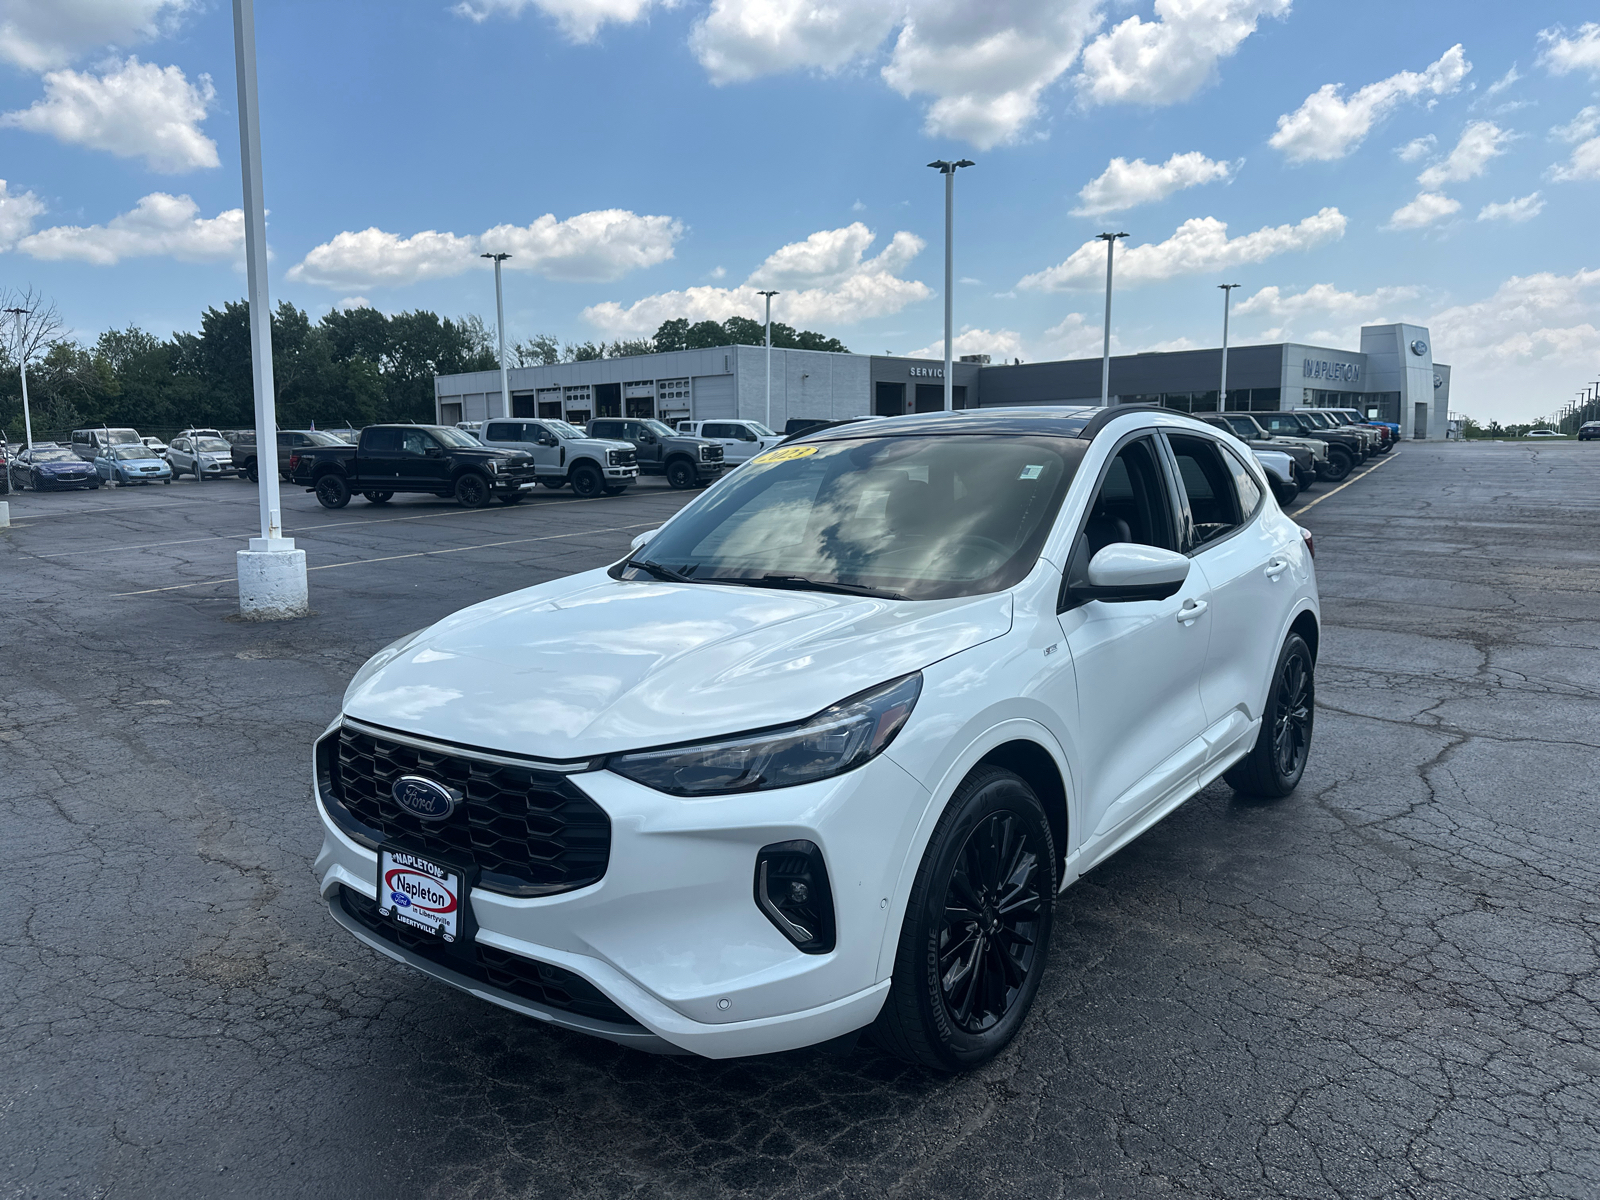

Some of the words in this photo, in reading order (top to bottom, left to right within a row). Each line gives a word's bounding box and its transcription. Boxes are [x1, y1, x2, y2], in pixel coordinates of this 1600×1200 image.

[1303, 358, 1360, 382] NAPLETON
[403, 784, 436, 812] Ford
[395, 852, 441, 878] NAPLETON
[394, 893, 408, 906] Ford
[396, 873, 445, 907] Napleton
[396, 914, 436, 935] LIBERTYVILLE
[412, 905, 418, 913] in
[418, 908, 451, 927] Libertyville
[927, 927, 952, 1043] BRIDGESTONE
